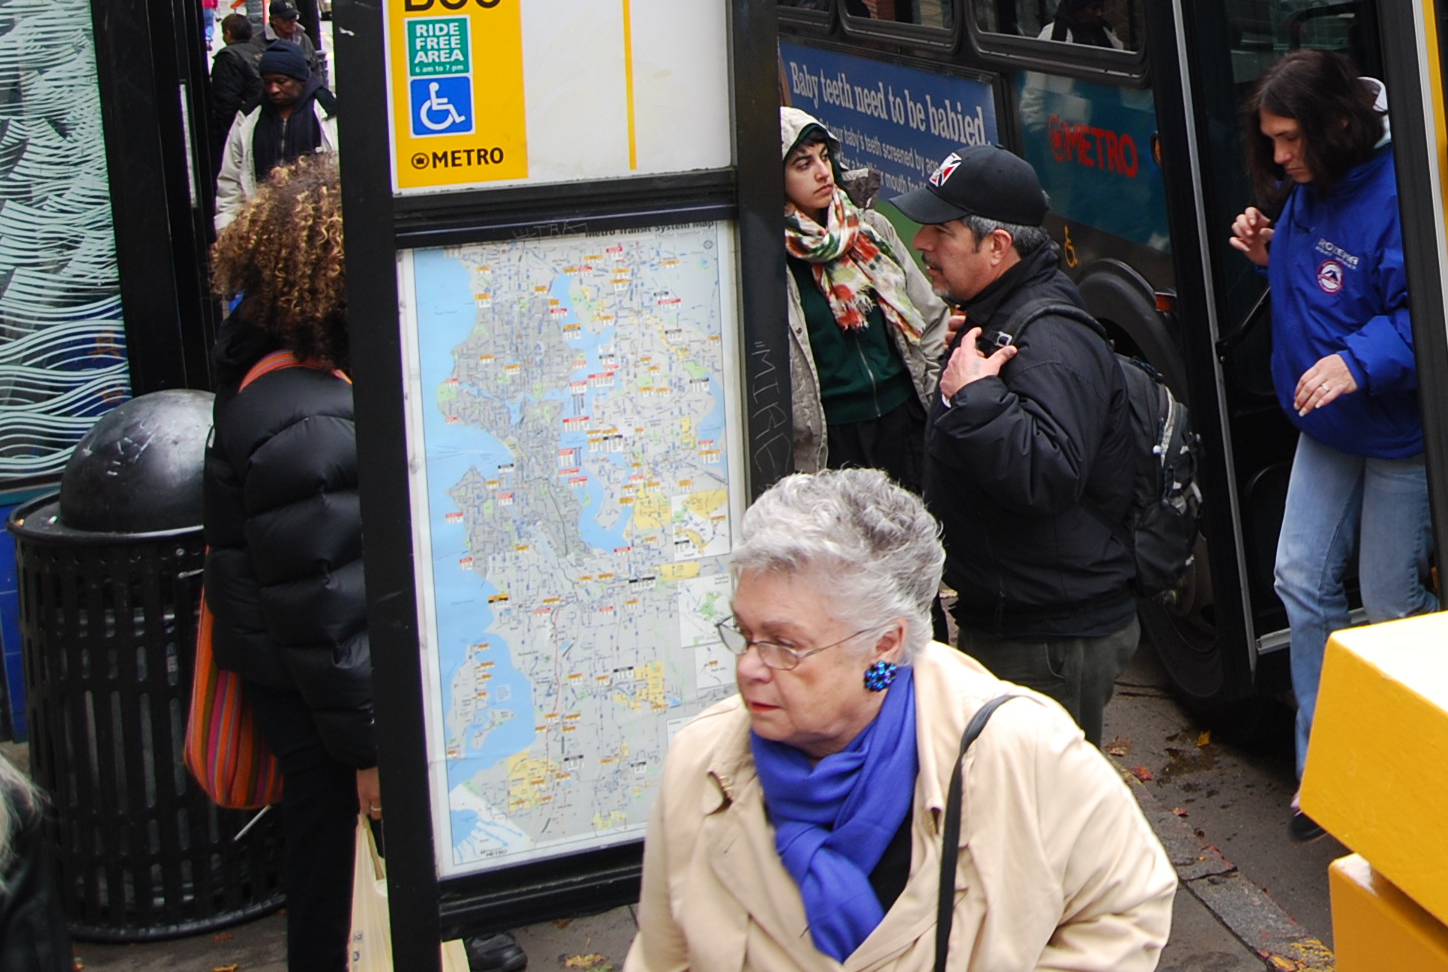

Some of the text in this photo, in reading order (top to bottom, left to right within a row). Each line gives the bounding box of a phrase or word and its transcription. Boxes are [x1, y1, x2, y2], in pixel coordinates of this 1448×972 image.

[415, 22, 460, 36] RIDE
[415, 36, 461, 50] FREE
[414, 49, 464, 63] AREA
[790, 61, 991, 146] Baby teeth need to be babied.
[431, 147, 504, 168] METRO
[865, 133, 882, 157] teeth
[882, 141, 914, 168] screened
[914, 148, 925, 177] by
[1064, 120, 1138, 178] METRO
